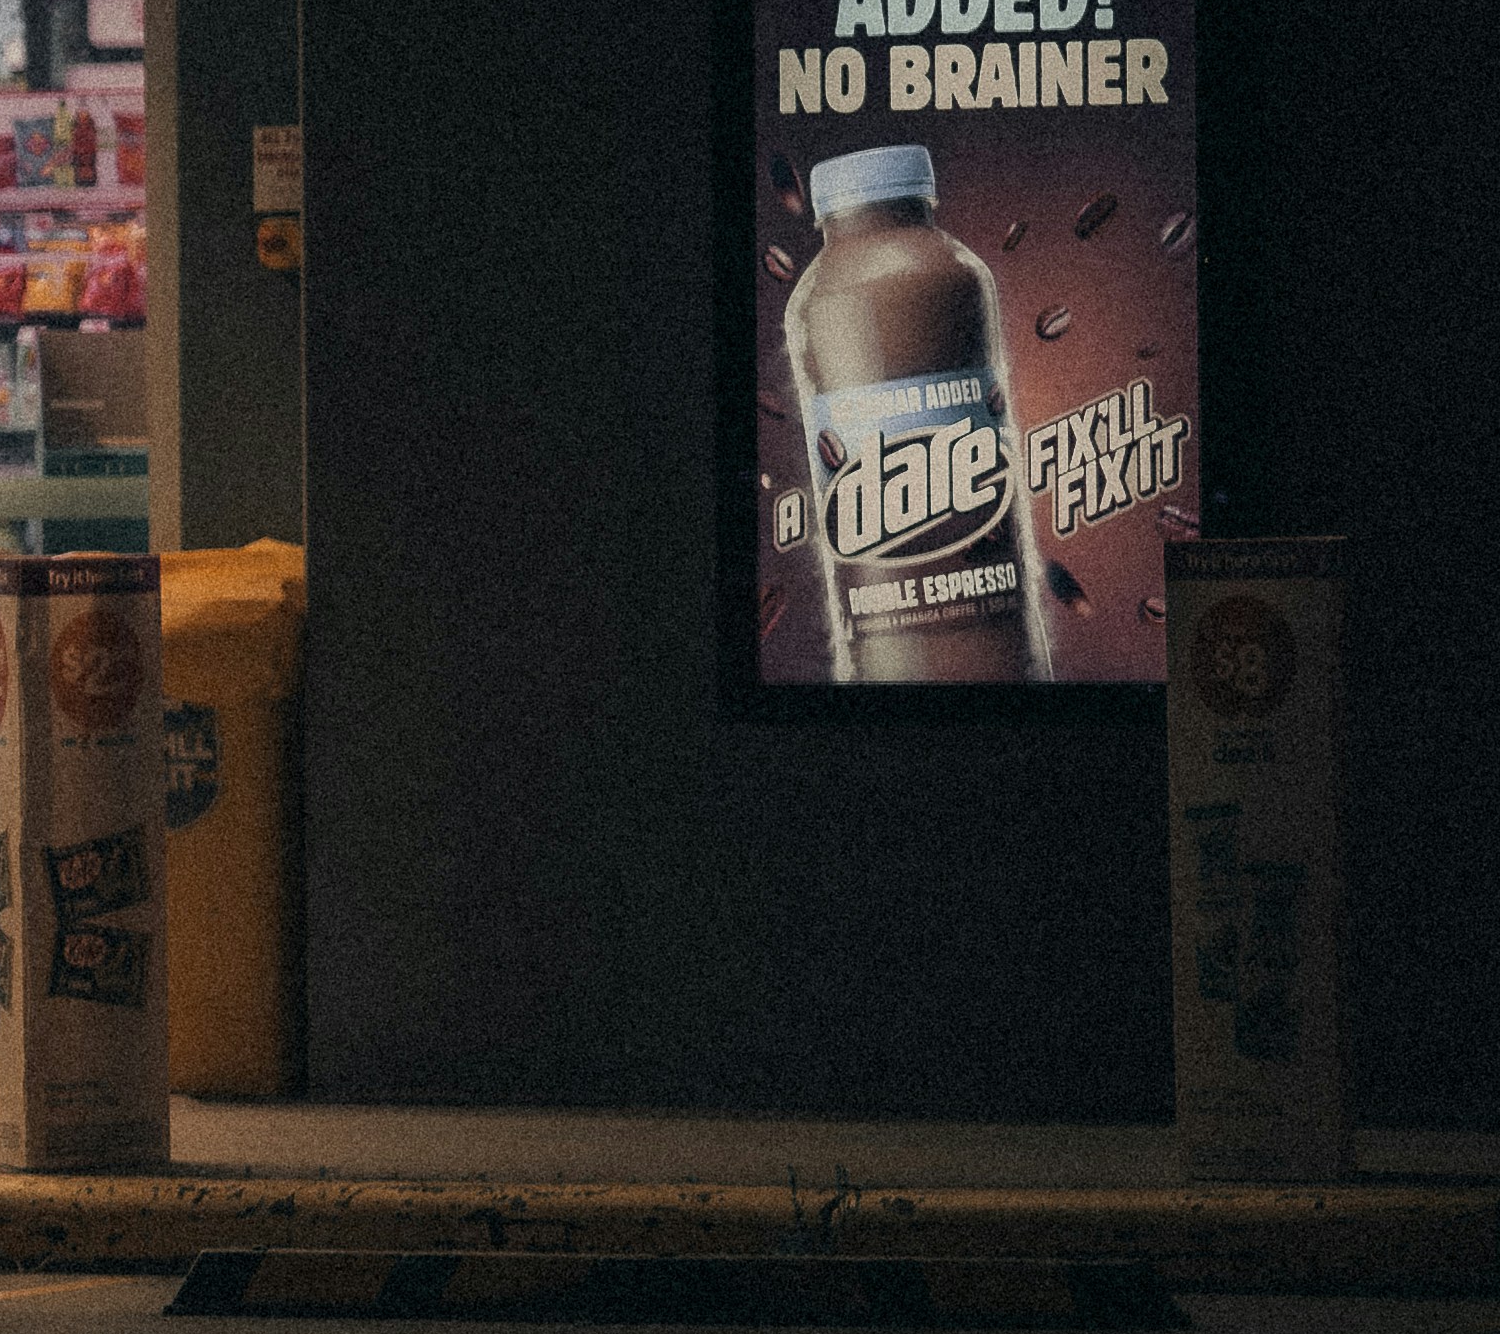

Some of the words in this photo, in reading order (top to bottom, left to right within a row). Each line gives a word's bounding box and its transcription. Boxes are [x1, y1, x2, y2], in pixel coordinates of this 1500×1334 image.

[779, 47, 867, 114] NO
[890, 39, 1169, 111] BRAINER
[926, 378, 982, 410] ADDED
[837, 417, 999, 558] dare
[1057, 445, 1127, 531] FIX
[1139, 420, 1183, 493] IT
[923, 562, 1017, 605] ESPRESSO
